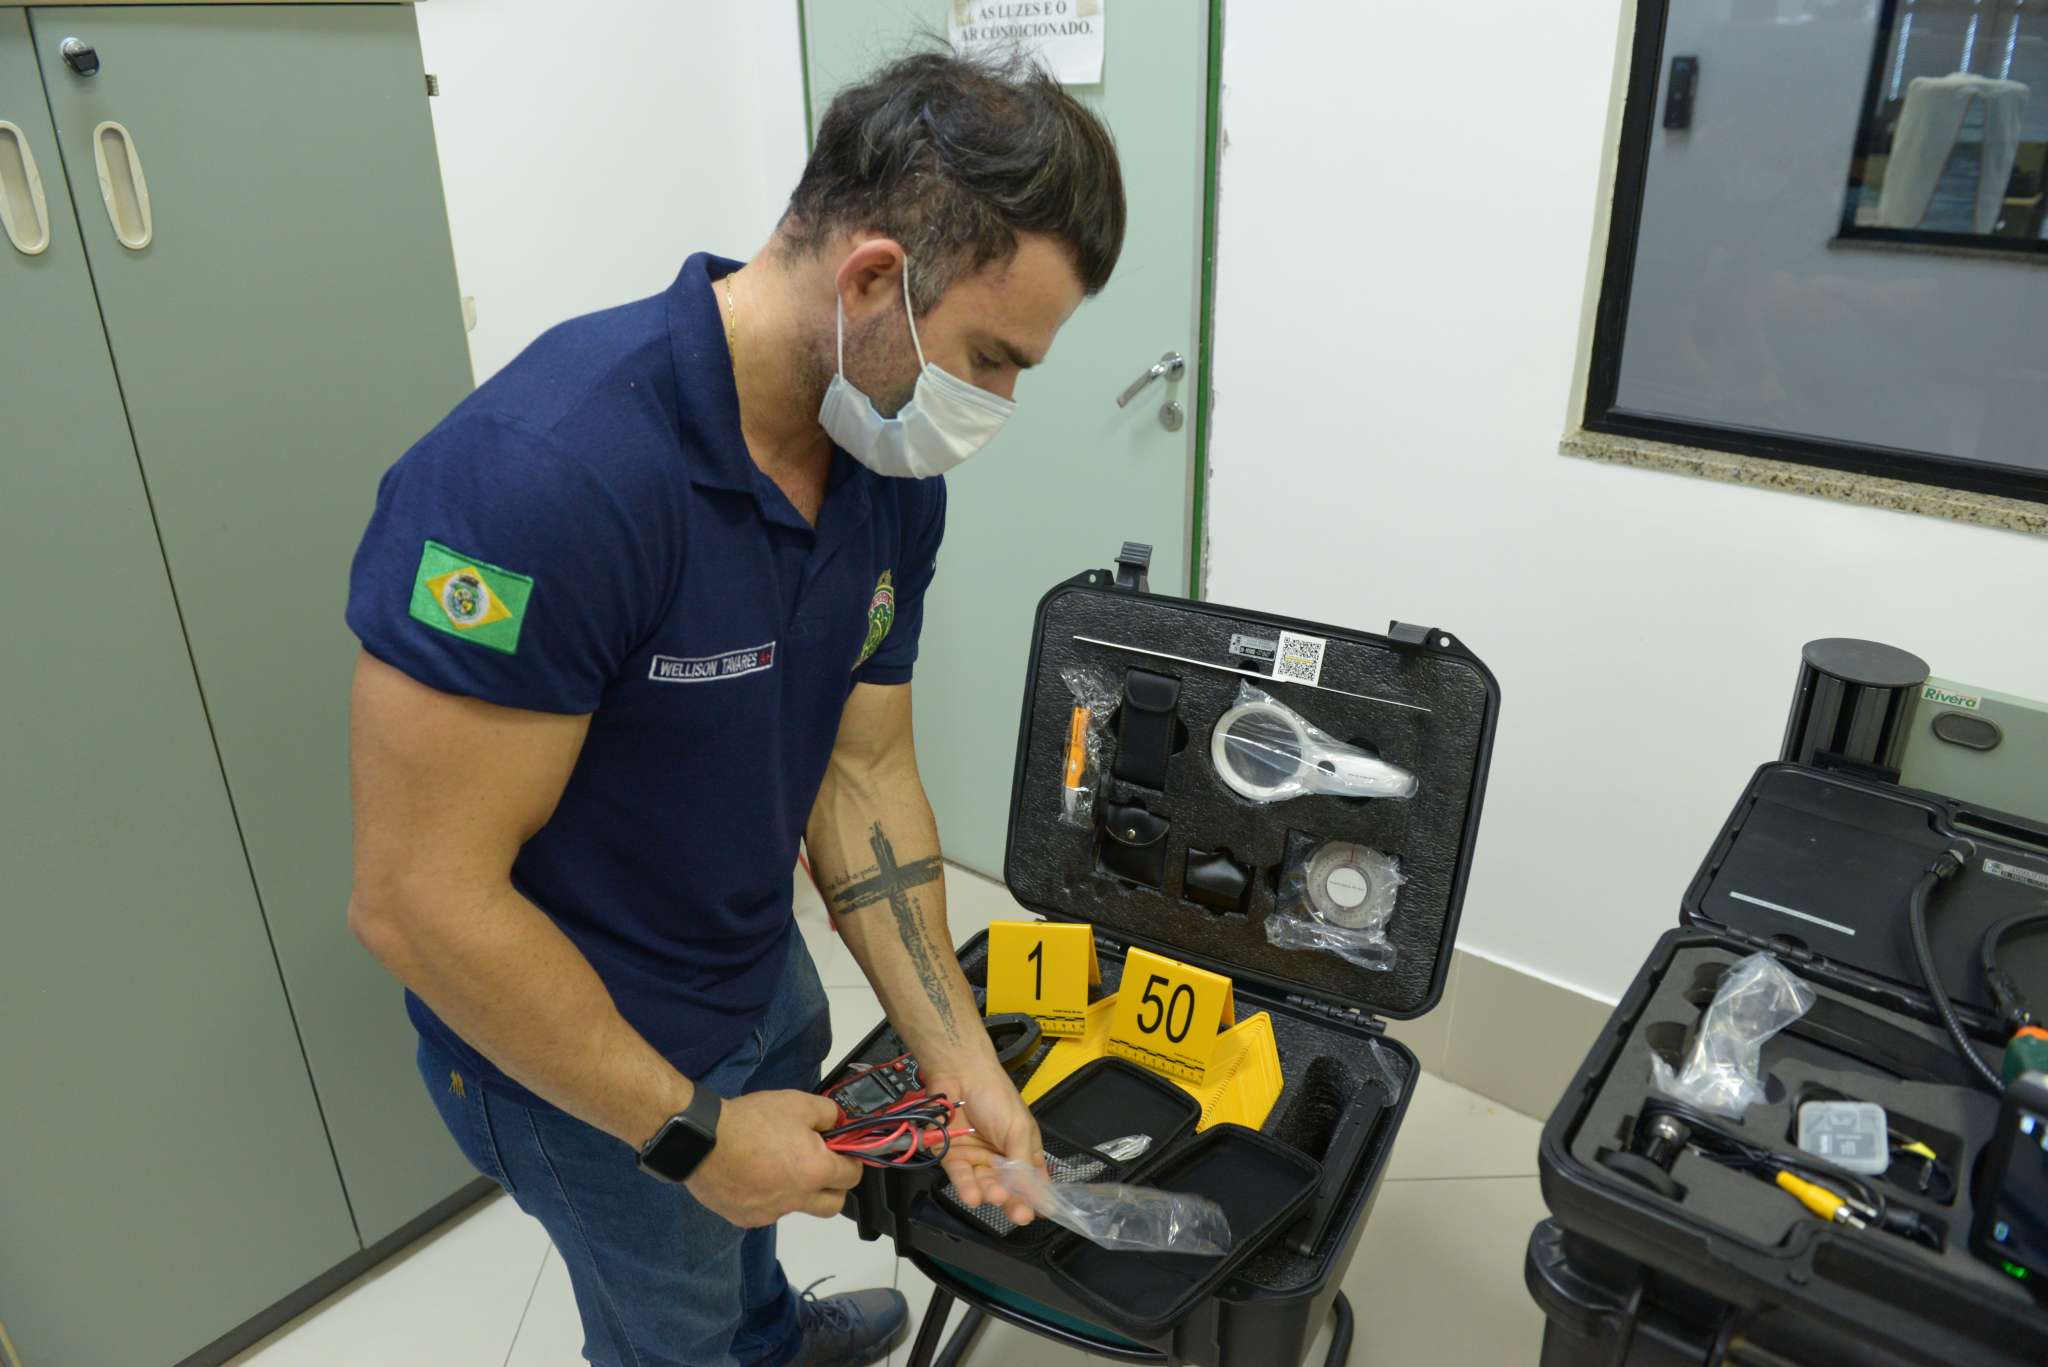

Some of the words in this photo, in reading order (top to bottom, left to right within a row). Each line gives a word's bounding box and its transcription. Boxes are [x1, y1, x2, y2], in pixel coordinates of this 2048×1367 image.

[980, 6, 995, 19] AS
[998, 3, 1041, 18] LUZES
[1056, 1, 1067, 14] O
[961, 28, 979, 41] AR
[660, 660, 718, 677] WELLISON
[721, 652, 758, 673] TAVARES
[1924, 687, 1977, 708] Rivera
[1027, 940, 1043, 1001] 1
[1137, 974, 1195, 1043] 50
